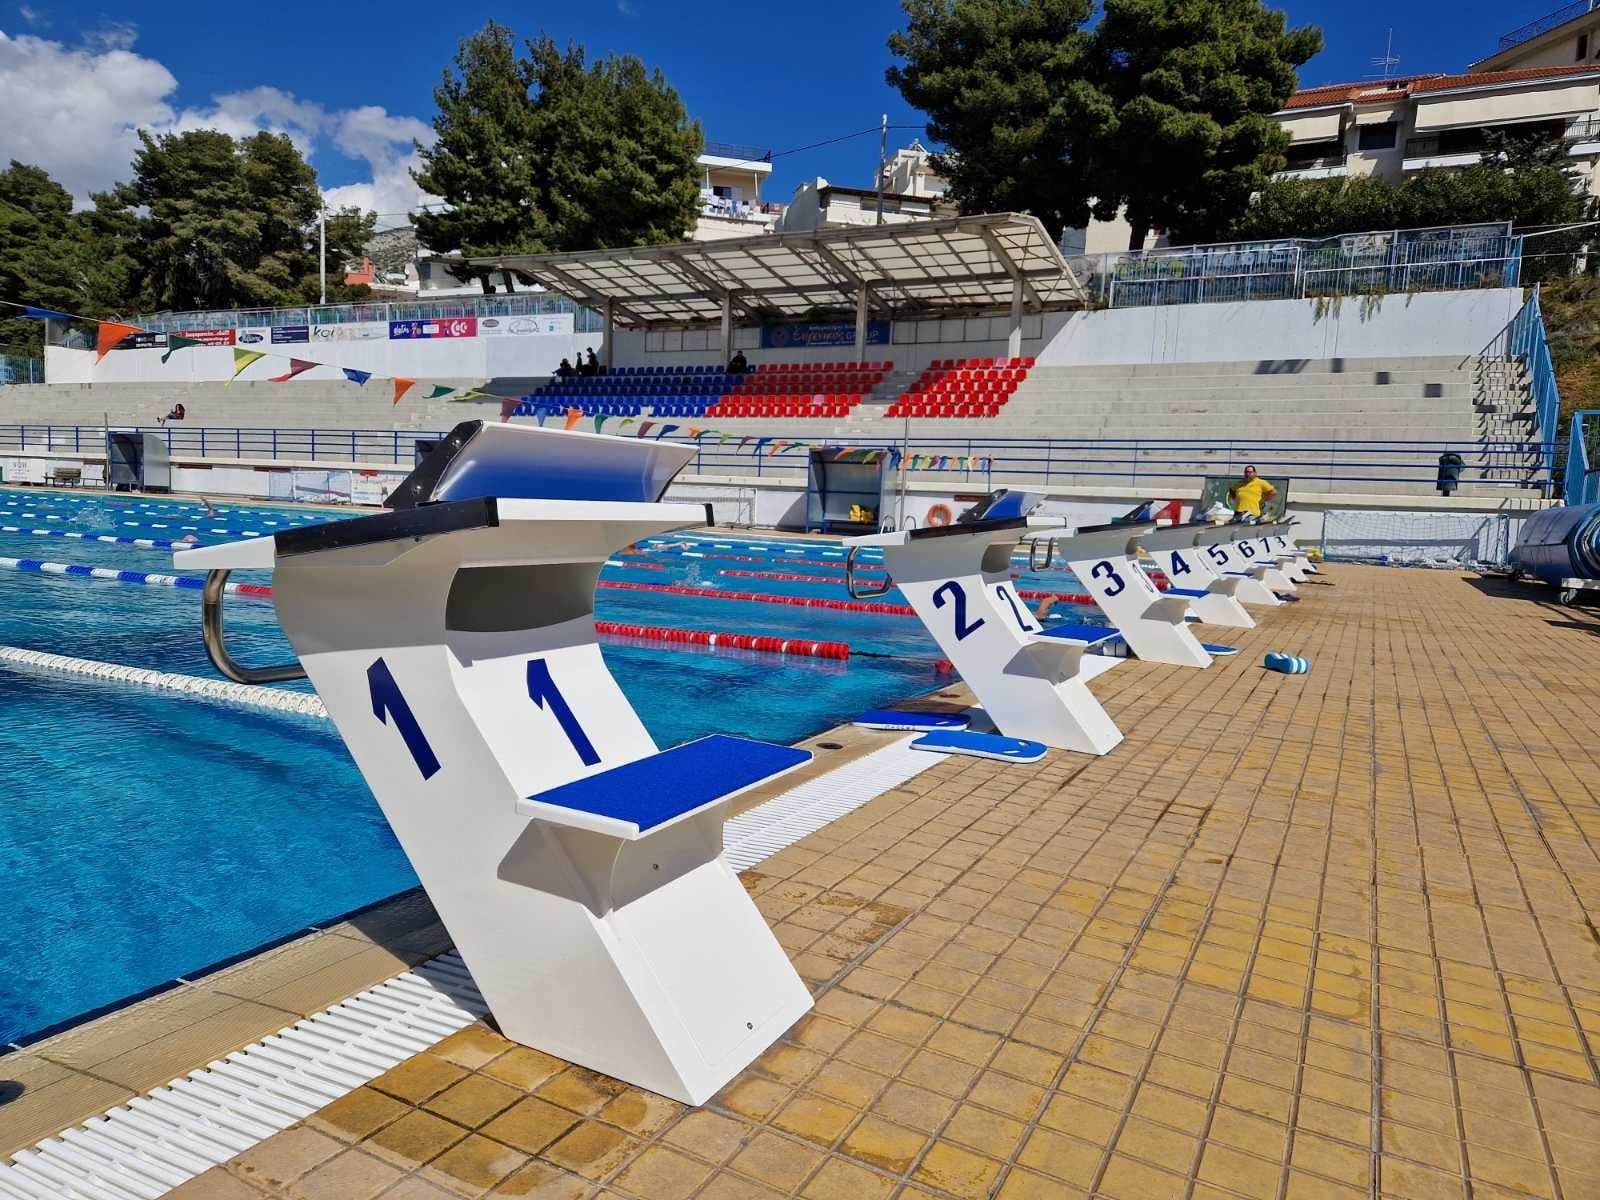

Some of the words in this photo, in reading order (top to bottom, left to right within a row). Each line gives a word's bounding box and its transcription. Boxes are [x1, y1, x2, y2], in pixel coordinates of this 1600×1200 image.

[1170, 550, 1192, 576] 4
[1207, 543, 1230, 566] 5
[1238, 540, 1256, 559] 6
[1259, 537, 1271, 554] 7
[1091, 560, 1126, 597] 3
[933, 580, 986, 642] 2
[995, 585, 1034, 632] 2
[366, 656, 442, 782] 1
[526, 658, 602, 767] 1
